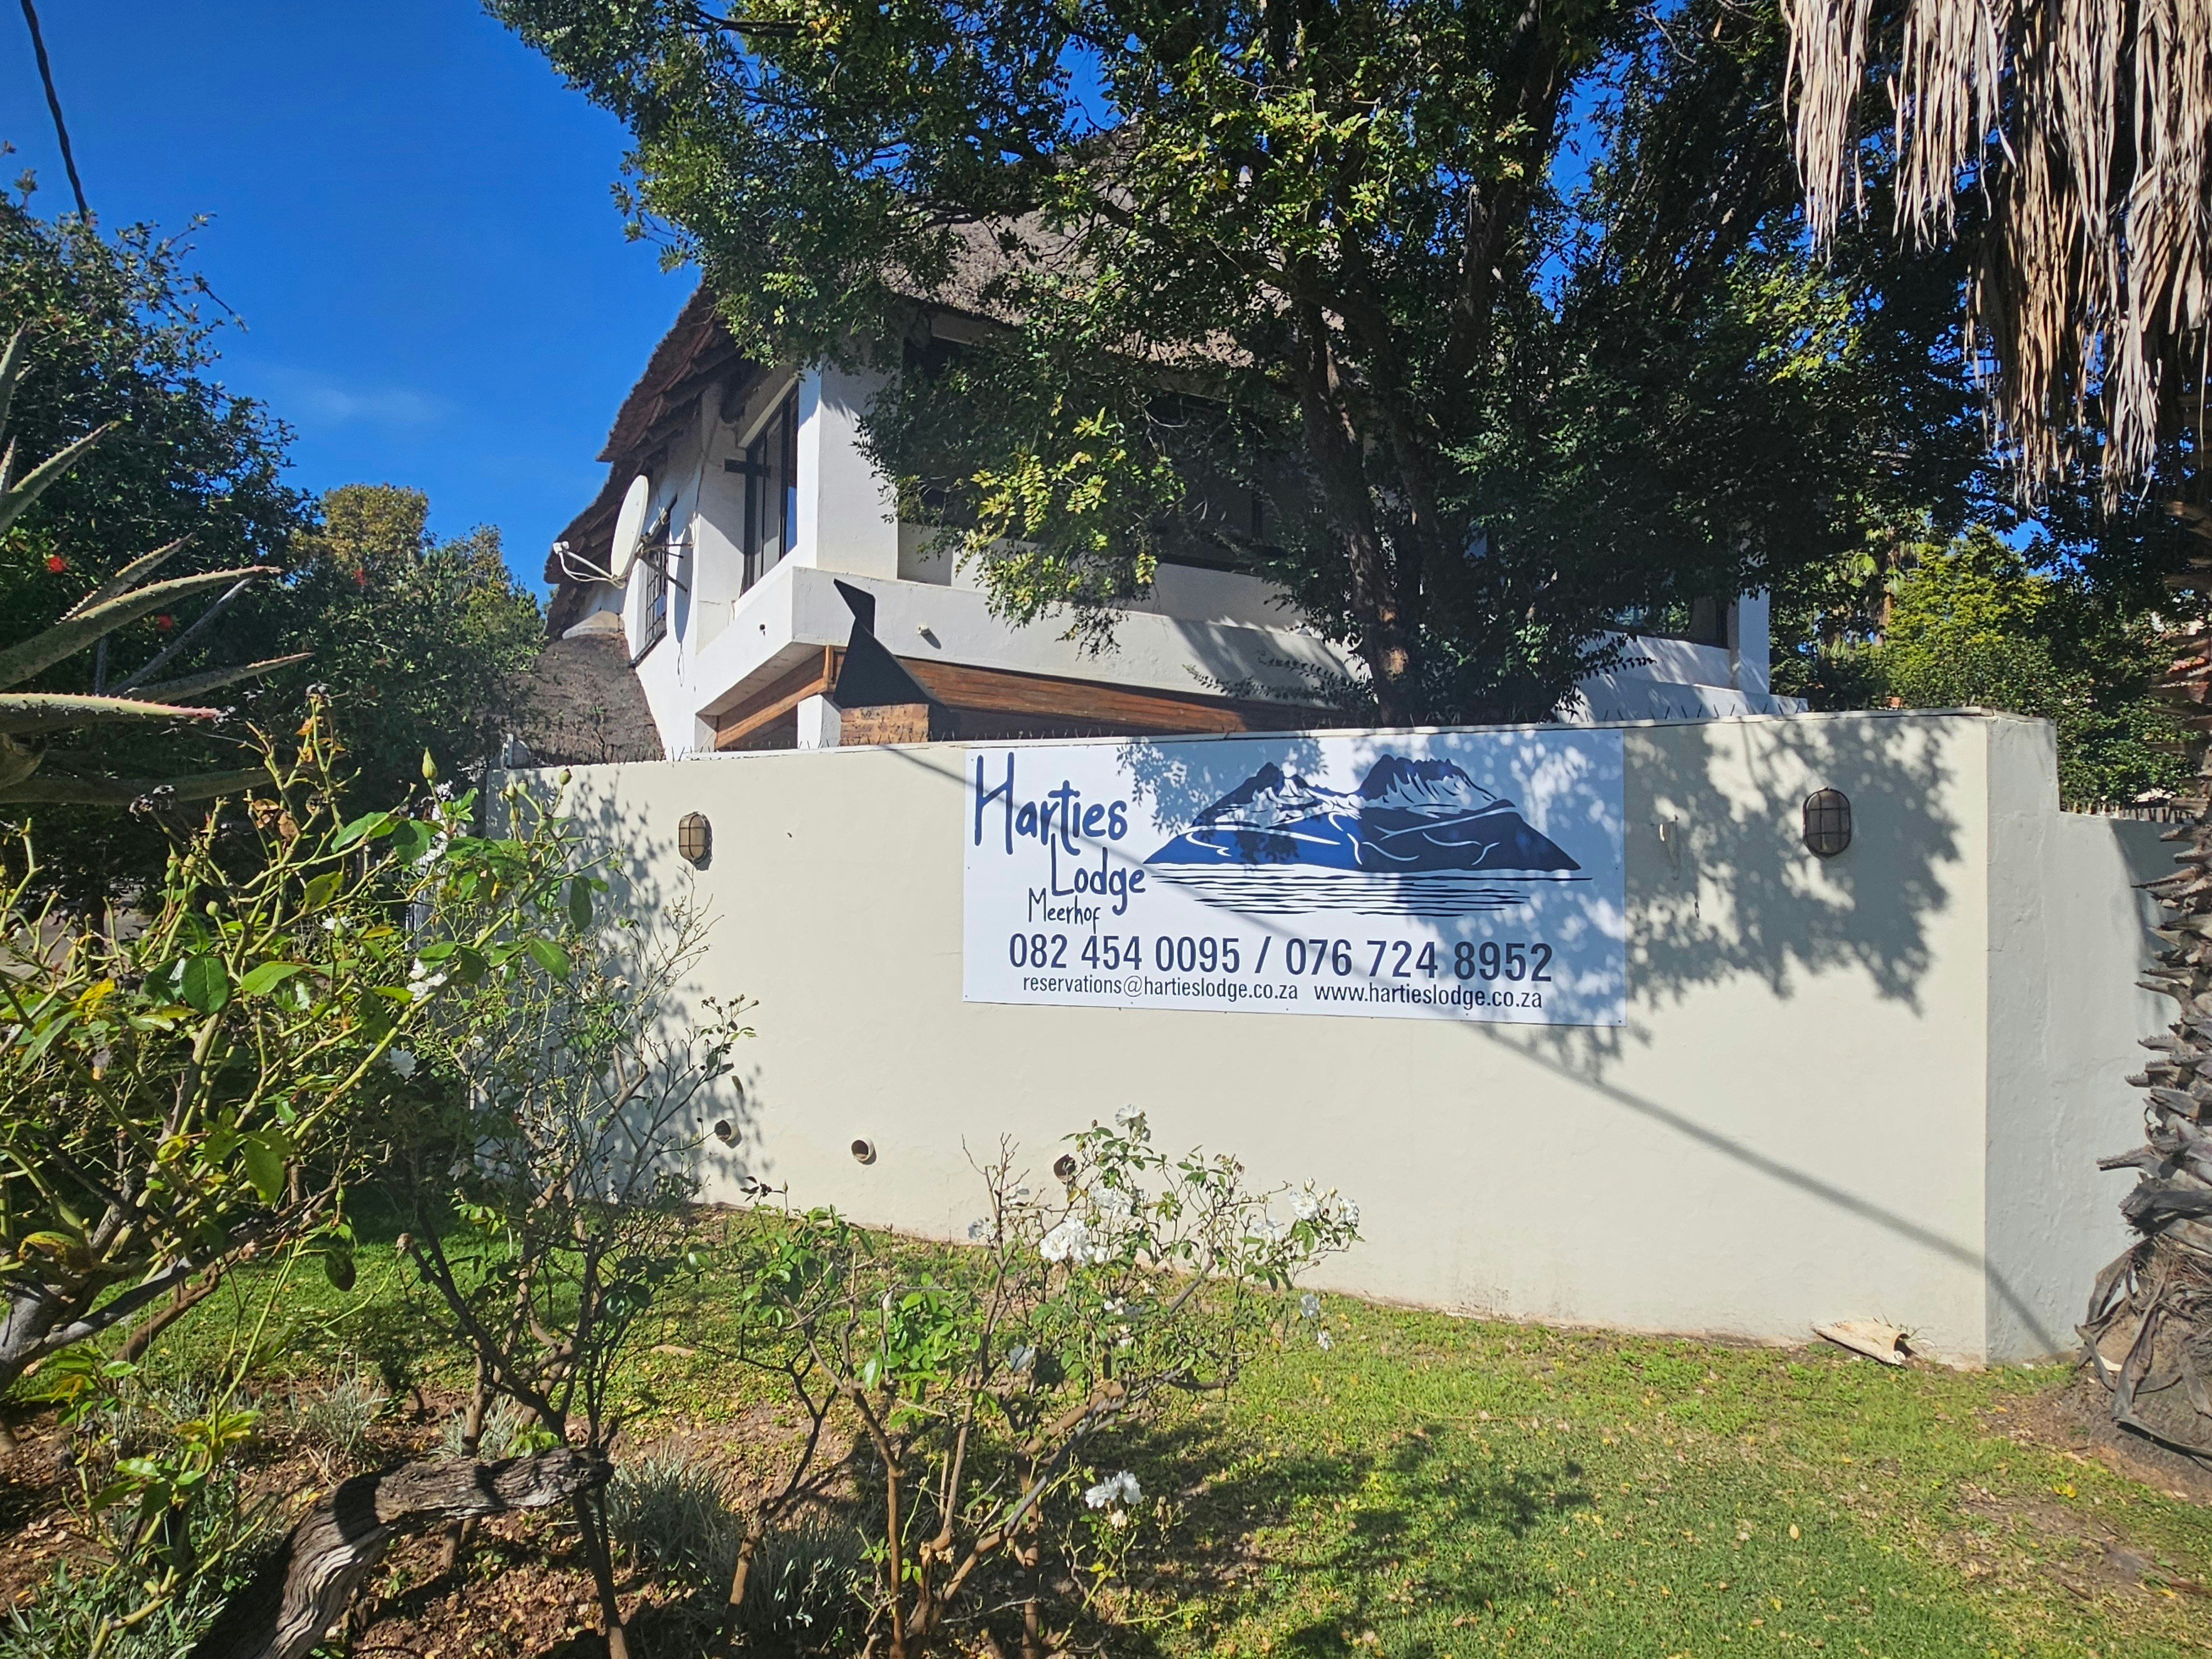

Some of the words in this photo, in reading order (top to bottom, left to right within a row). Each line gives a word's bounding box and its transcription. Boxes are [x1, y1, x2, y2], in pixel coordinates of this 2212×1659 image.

[974, 752, 1128, 855] Harties
[1051, 833, 1146, 916] Lodge
[1028, 887, 1101, 934] Meerhof
[1009, 933, 1067, 968] 082
[1081, 935, 1142, 971] 454
[1155, 936, 1240, 974] 0095
[1254, 936, 1272, 974] /
[1285, 938, 1352, 977] 076
[1366, 940, 1438, 979] 724
[1454, 941, 1552, 982] 8952
[1023, 974, 1298, 1002] reservations@hartieslodge.co.za
[1314, 983, 1542, 1010] www.hartieslodge.co.za
